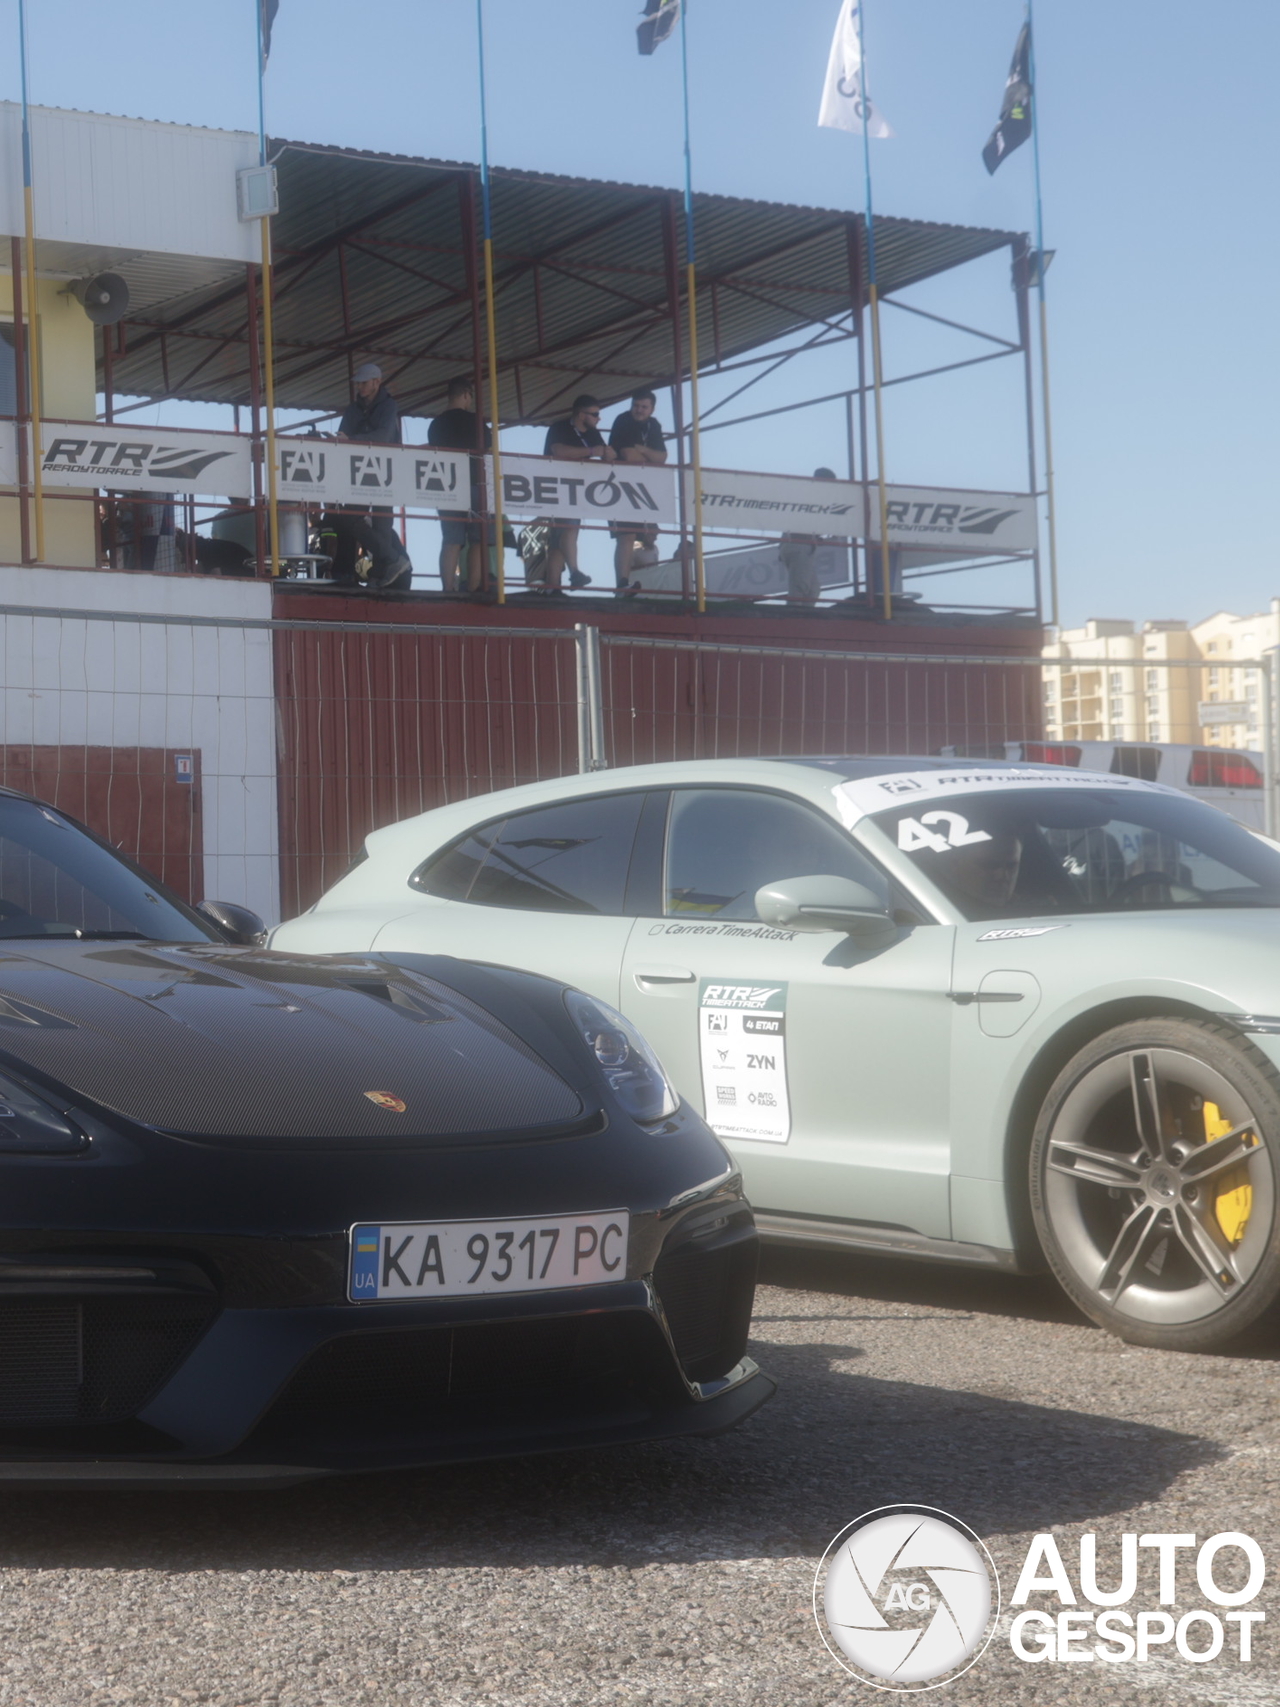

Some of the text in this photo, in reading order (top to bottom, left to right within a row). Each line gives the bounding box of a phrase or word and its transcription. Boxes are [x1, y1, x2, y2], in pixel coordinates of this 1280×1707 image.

[44, 438, 154, 467] RTR
[42, 463, 143, 476] READYTORACE
[886, 501, 961, 525] RTR
[898, 810, 993, 853] 42
[703, 985, 752, 1000] RTR
[702, 999, 766, 1008] TIMEATTACK
[746, 1020, 779, 1031] 4 ЕТАП
[746, 1054, 776, 1070] ZYN
[758, 1092, 774, 1100] AVTO
[758, 1099, 777, 1107] RADIO
[382, 1223, 623, 1287] KA 9317 PC
[355, 1273, 375, 1288] UA
